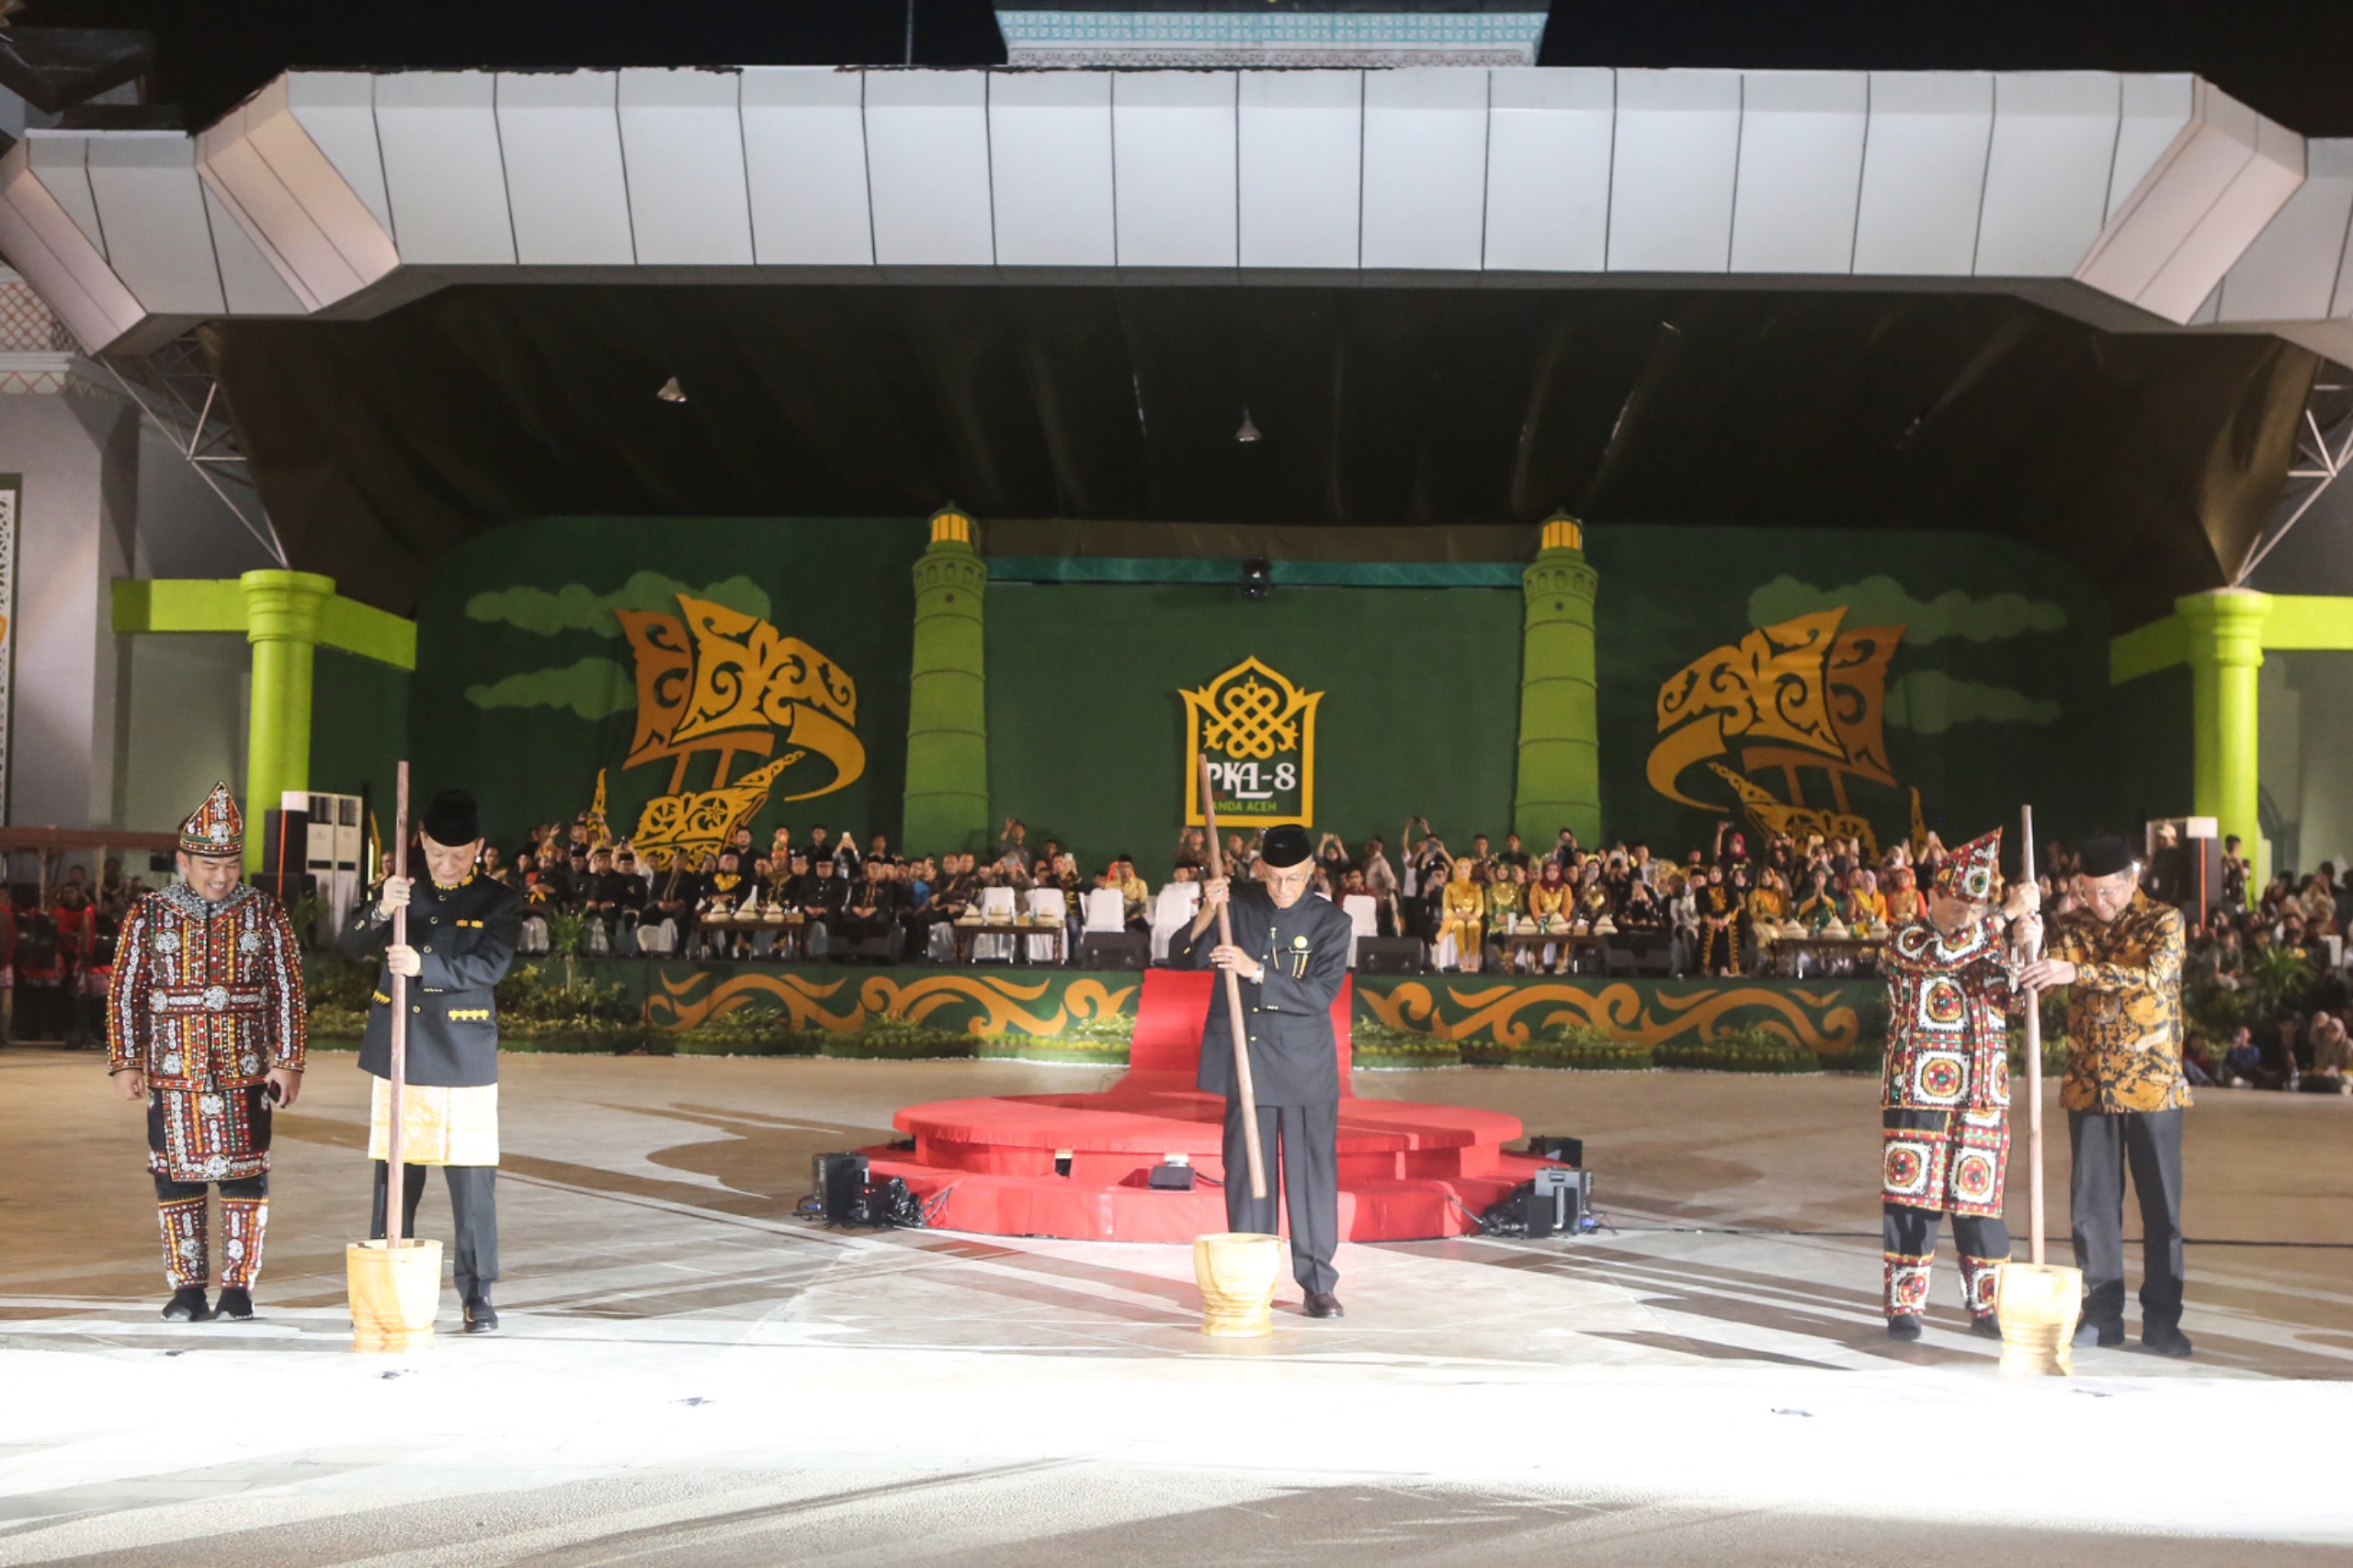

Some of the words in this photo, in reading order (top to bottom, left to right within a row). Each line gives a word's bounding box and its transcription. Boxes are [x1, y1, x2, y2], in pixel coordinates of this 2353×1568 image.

[1206, 762, 1296, 799] PKA-8
[1212, 801, 1243, 812] ANDA
[1246, 801, 1277, 812] ACEH
